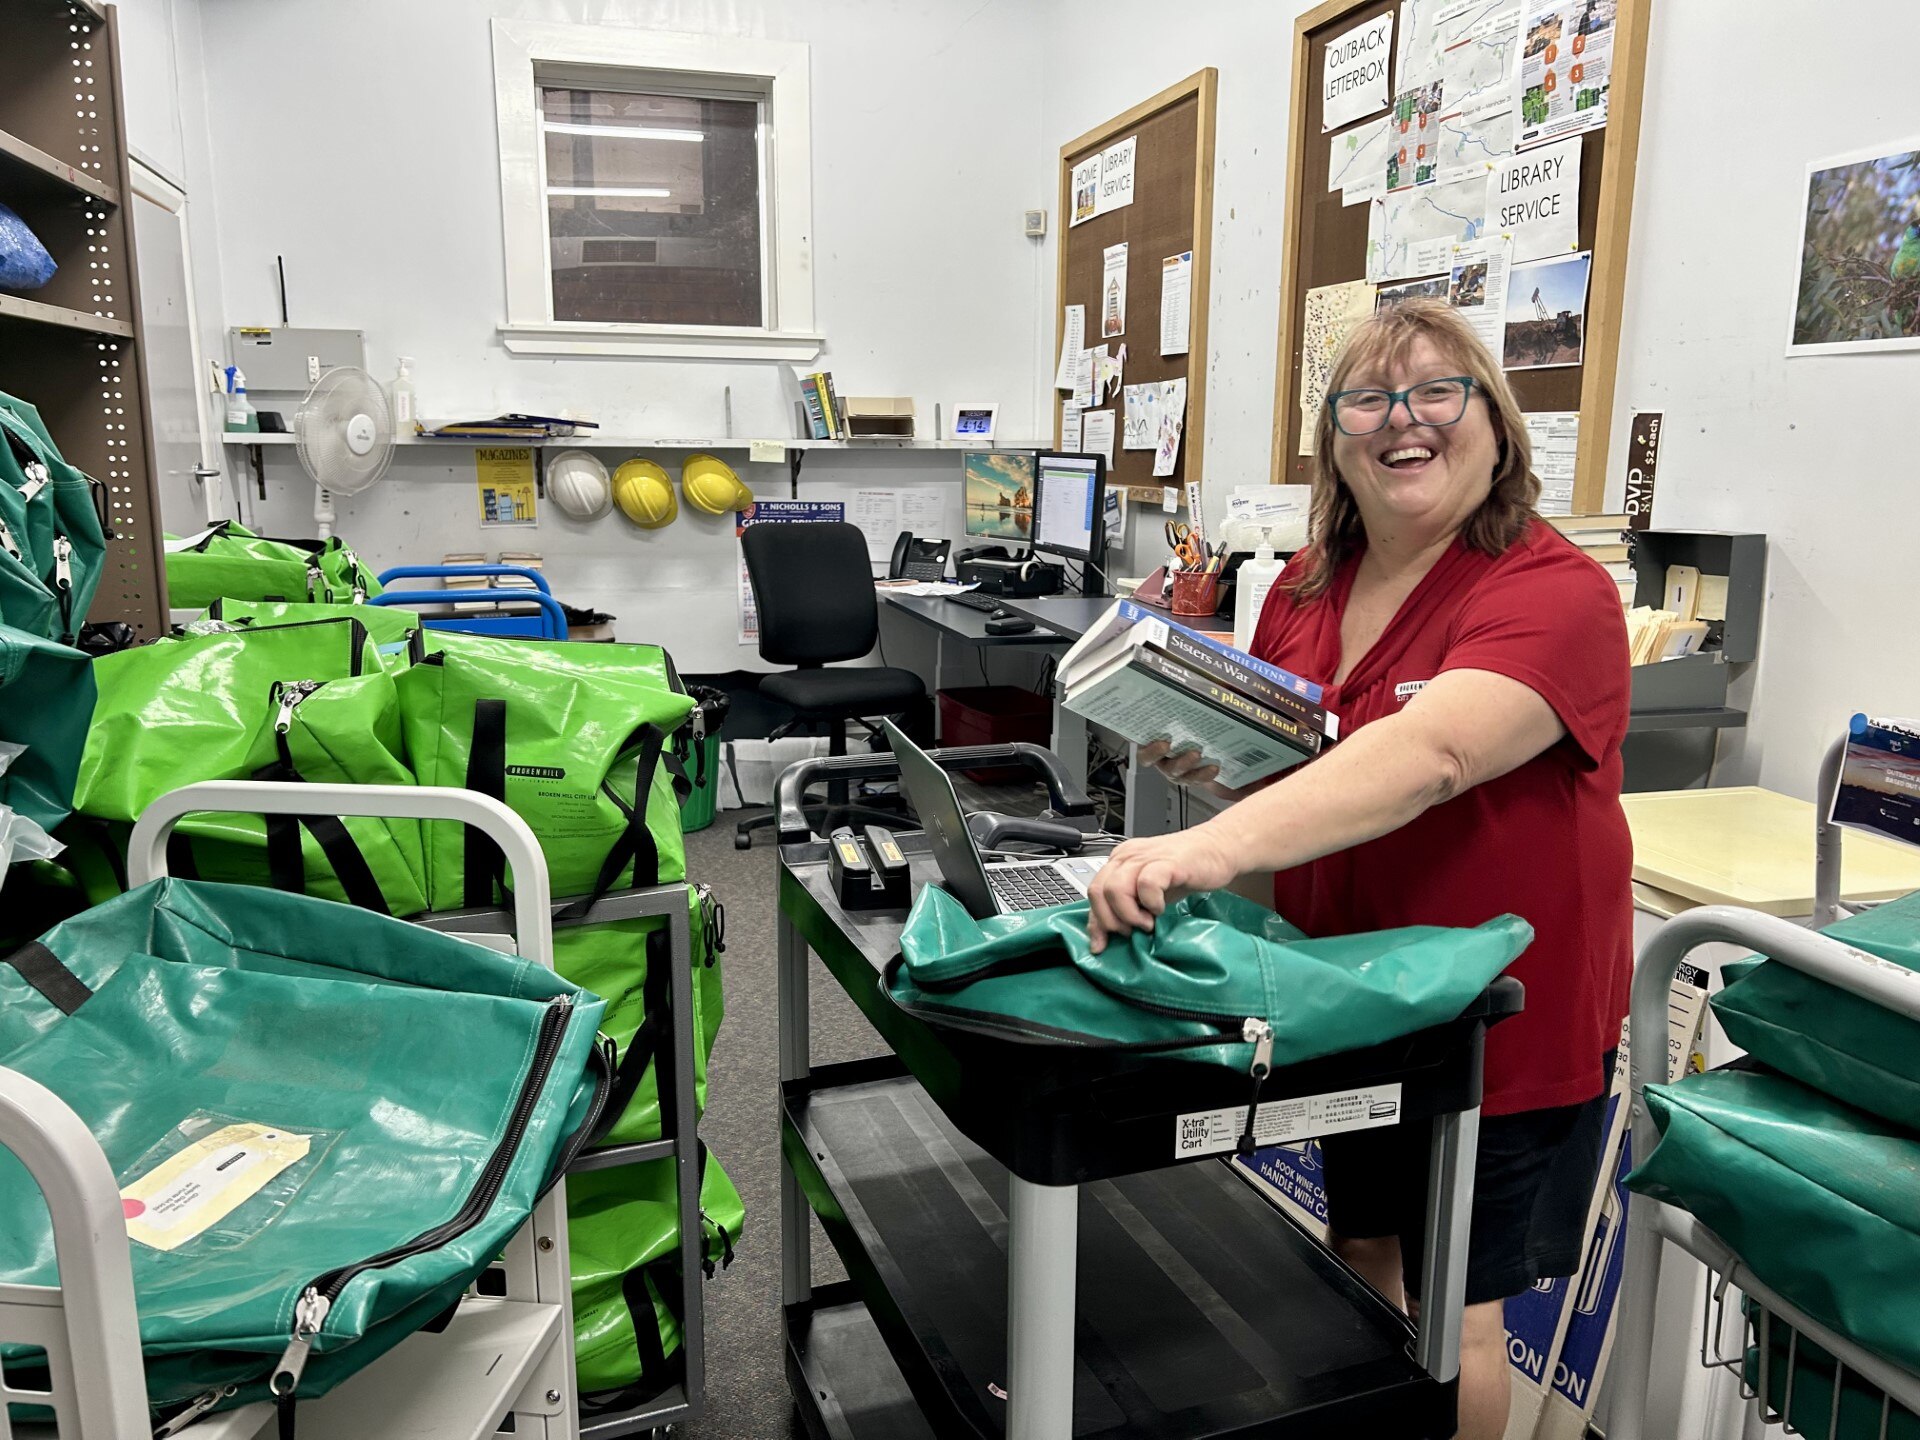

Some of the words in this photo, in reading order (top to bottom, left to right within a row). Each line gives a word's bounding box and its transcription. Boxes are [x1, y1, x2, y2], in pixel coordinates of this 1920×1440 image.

[1330, 26, 1386, 68] OUTBACK
[1326, 57, 1385, 101] LETTERBOX
[1104, 147, 1133, 173] LIBRARY
[1500, 155, 1564, 193] LIBRARY
[1076, 164, 1097, 187] HOME
[1103, 174, 1131, 198] SERVICE
[1500, 194, 1560, 227] SERVICE
[1648, 419, 1659, 447] each
[480, 448, 530, 461] MAGAZINES
[1645, 450, 1655, 465] $2
[760, 503, 768, 511] T.
[770, 503, 809, 511] NICHOLLS
[811, 503, 818, 511] &
[820, 503, 841, 511] SONS
[1626, 468, 1643, 516] DVD
[1641, 474, 1654, 513] SALE
[1170, 634, 1213, 665] Sisters
[1224, 661, 1249, 684] War
[1223, 649, 1250, 667] KATIE
[1253, 661, 1287, 683] FLYNN
[1210, 686, 1218, 696] a
[1221, 692, 1253, 713] place
[1256, 708, 1269, 721] to
[1272, 715, 1298, 735] land
[511, 766, 541, 776] BROKEN
[542, 769, 559, 777] HILL
[1886, 768, 1915, 782] OUTBACK
[1181, 1138, 1202, 1150] Cart
[1182, 1127, 1209, 1139] Utility
[1260, 1162, 1294, 1194] HANDLE
[1294, 1185, 1315, 1210] WITH
[1275, 1158, 1295, 1179] BOOK
[1296, 1172, 1313, 1192] WINE
